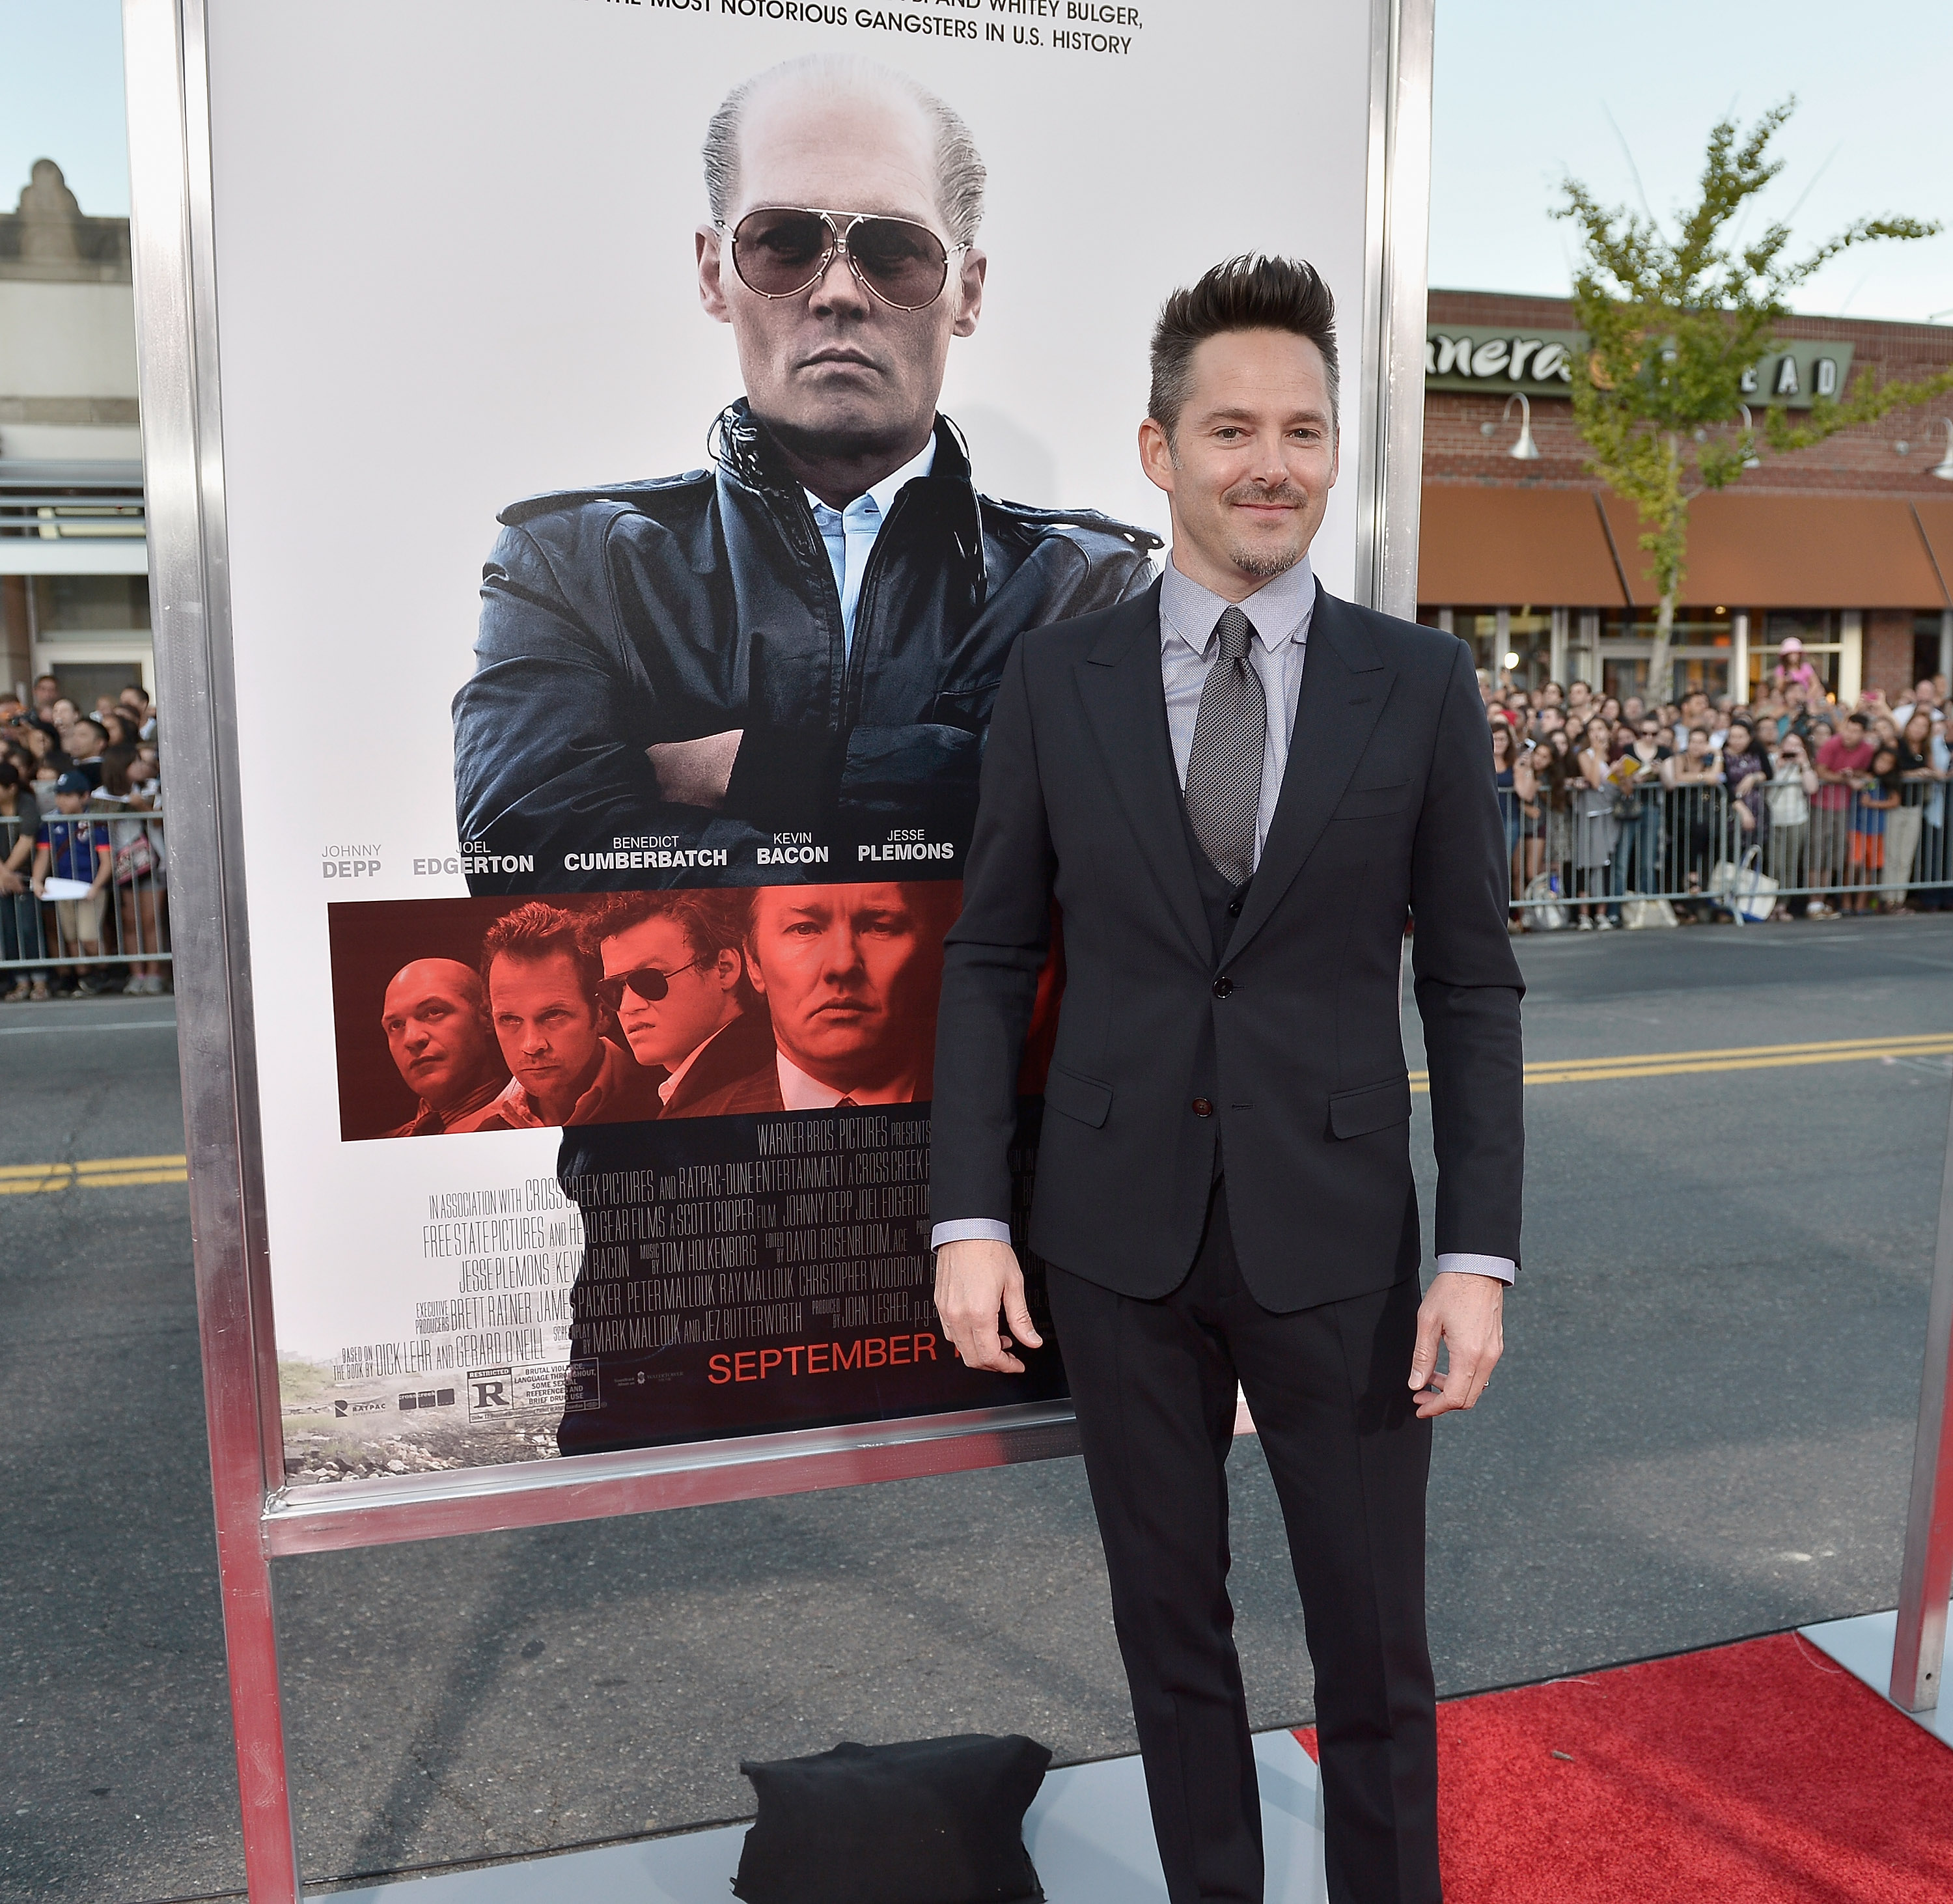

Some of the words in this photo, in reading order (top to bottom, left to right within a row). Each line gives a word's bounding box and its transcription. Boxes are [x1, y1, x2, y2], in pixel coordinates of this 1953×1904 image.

[990, 0, 1059, 18] WHITEY
[1067, 3, 1143, 29] BULGER,
[721, 0, 848, 25] NOTORIOUS
[855, 9, 977, 39] GANGSTERS
[986, 23, 1004, 42] IN
[1014, 25, 1044, 46] U.S.
[1053, 29, 1132, 54] HISTORY
[1426, 335, 1572, 382] nera
[613, 836, 679, 849] BENEDICT
[773, 832, 812, 845] KEVIN
[887, 829, 925, 842] JESSE
[322, 844, 382, 857] JOHNNY
[456, 840, 491, 854] JOEL
[757, 847, 829, 865] BACON
[858, 843, 954, 862] PLEMONS
[322, 860, 382, 878] DEPP
[413, 855, 534, 875] EDGERTON
[564, 849, 727, 871] CUMBERBATCH
[757, 1122, 804, 1155] WARNER
[807, 1119, 837, 1152] BROS.
[840, 1116, 887, 1150] PICTURES
[891, 1120, 931, 1146] PRESENTS
[429, 1195, 439, 1219] IN
[441, 1191, 497, 1219] ASSOCIATION
[498, 1188, 521, 1213] WITH
[525, 1177, 562, 1211] CROSS
[565, 1174, 600, 1208] CREEK
[603, 1170, 654, 1204] PICTURES
[659, 1176, 676, 1200] AND
[679, 1162, 754, 1198] RATPAC-DUNE
[756, 1155, 844, 1193] ENTERTAINMENT
[855, 1152, 889, 1185] CROSS
[891, 1150, 923, 1181] CREEK
[423, 1224, 452, 1258] FREE
[454, 1221, 490, 1256] STATE
[492, 1217, 544, 1252] PICTURES
[549, 1222, 566, 1247] AND
[568, 1211, 598, 1246] HEAD
[600, 1209, 630, 1243] GEAR
[631, 1206, 665, 1240] FILMS
[677, 1202, 711, 1237] SCOTT
[715, 1199, 755, 1233] COOPER
[756, 1204, 777, 1228] FILM
[783, 1193, 825, 1227] JOHNNY
[828, 1191, 852, 1223] DEPP
[856, 1189, 879, 1221] JOEL
[640, 1243, 659, 1260] MUSIC
[660, 1241, 684, 1273] TOM
[688, 1235, 756, 1271] HOLKENBORG
[786, 1230, 816, 1262] DAVID
[893, 1228, 907, 1252] ACE
[777, 1248, 784, 1263] BY
[459, 1258, 493, 1293] JESSE
[495, 1253, 549, 1289] PLEMONS
[555, 1249, 589, 1284] KEVIN
[593, 1246, 630, 1280] BACON
[652, 1259, 659, 1275] BY
[450, 1297, 484, 1331] BRETT
[488, 1292, 532, 1328] RATNER
[537, 1288, 576, 1323] JAMES
[578, 1284, 621, 1318] PACKER
[627, 1279, 661, 1314] PETER
[663, 1275, 715, 1310] MALLOUK
[720, 1271, 740, 1304] RAY
[744, 1267, 794, 1302] MALLOUK
[799, 1261, 867, 1297] CHRISTOPHER
[870, 1255, 924, 1290] WOODROW
[416, 1300, 449, 1318] EXECUTIVE
[812, 1298, 840, 1315] PRODUCED
[842, 1296, 868, 1328] JOHN
[415, 1317, 449, 1334] PRODUCERS
[592, 1319, 628, 1354] MARK
[630, 1314, 681, 1351] MALLOUK
[684, 1319, 700, 1344] AND
[702, 1310, 721, 1342] JEZ
[724, 1302, 802, 1340] BUTTERWORTH
[833, 1314, 840, 1329] BY
[342, 1345, 362, 1363] BASED
[364, 1345, 373, 1361] ON
[376, 1342, 402, 1376] DICK
[404, 1339, 432, 1373] LEHR
[436, 1344, 454, 1370] AND
[456, 1332, 502, 1367] GERARD
[583, 1338, 590, 1355] BY
[708, 1332, 937, 1385] SEPTEMBER
[333, 1364, 345, 1381] THE
[347, 1363, 363, 1379] BOOK
[366, 1362, 374, 1377] BY
[469, 1369, 509, 1378] RESTRICTED
[514, 1374, 549, 1384] LANGUAGE
[472, 1381, 510, 1409] R
[526, 1387, 568, 1397] REFERENCES
[352, 1403, 386, 1413] RATPAC
